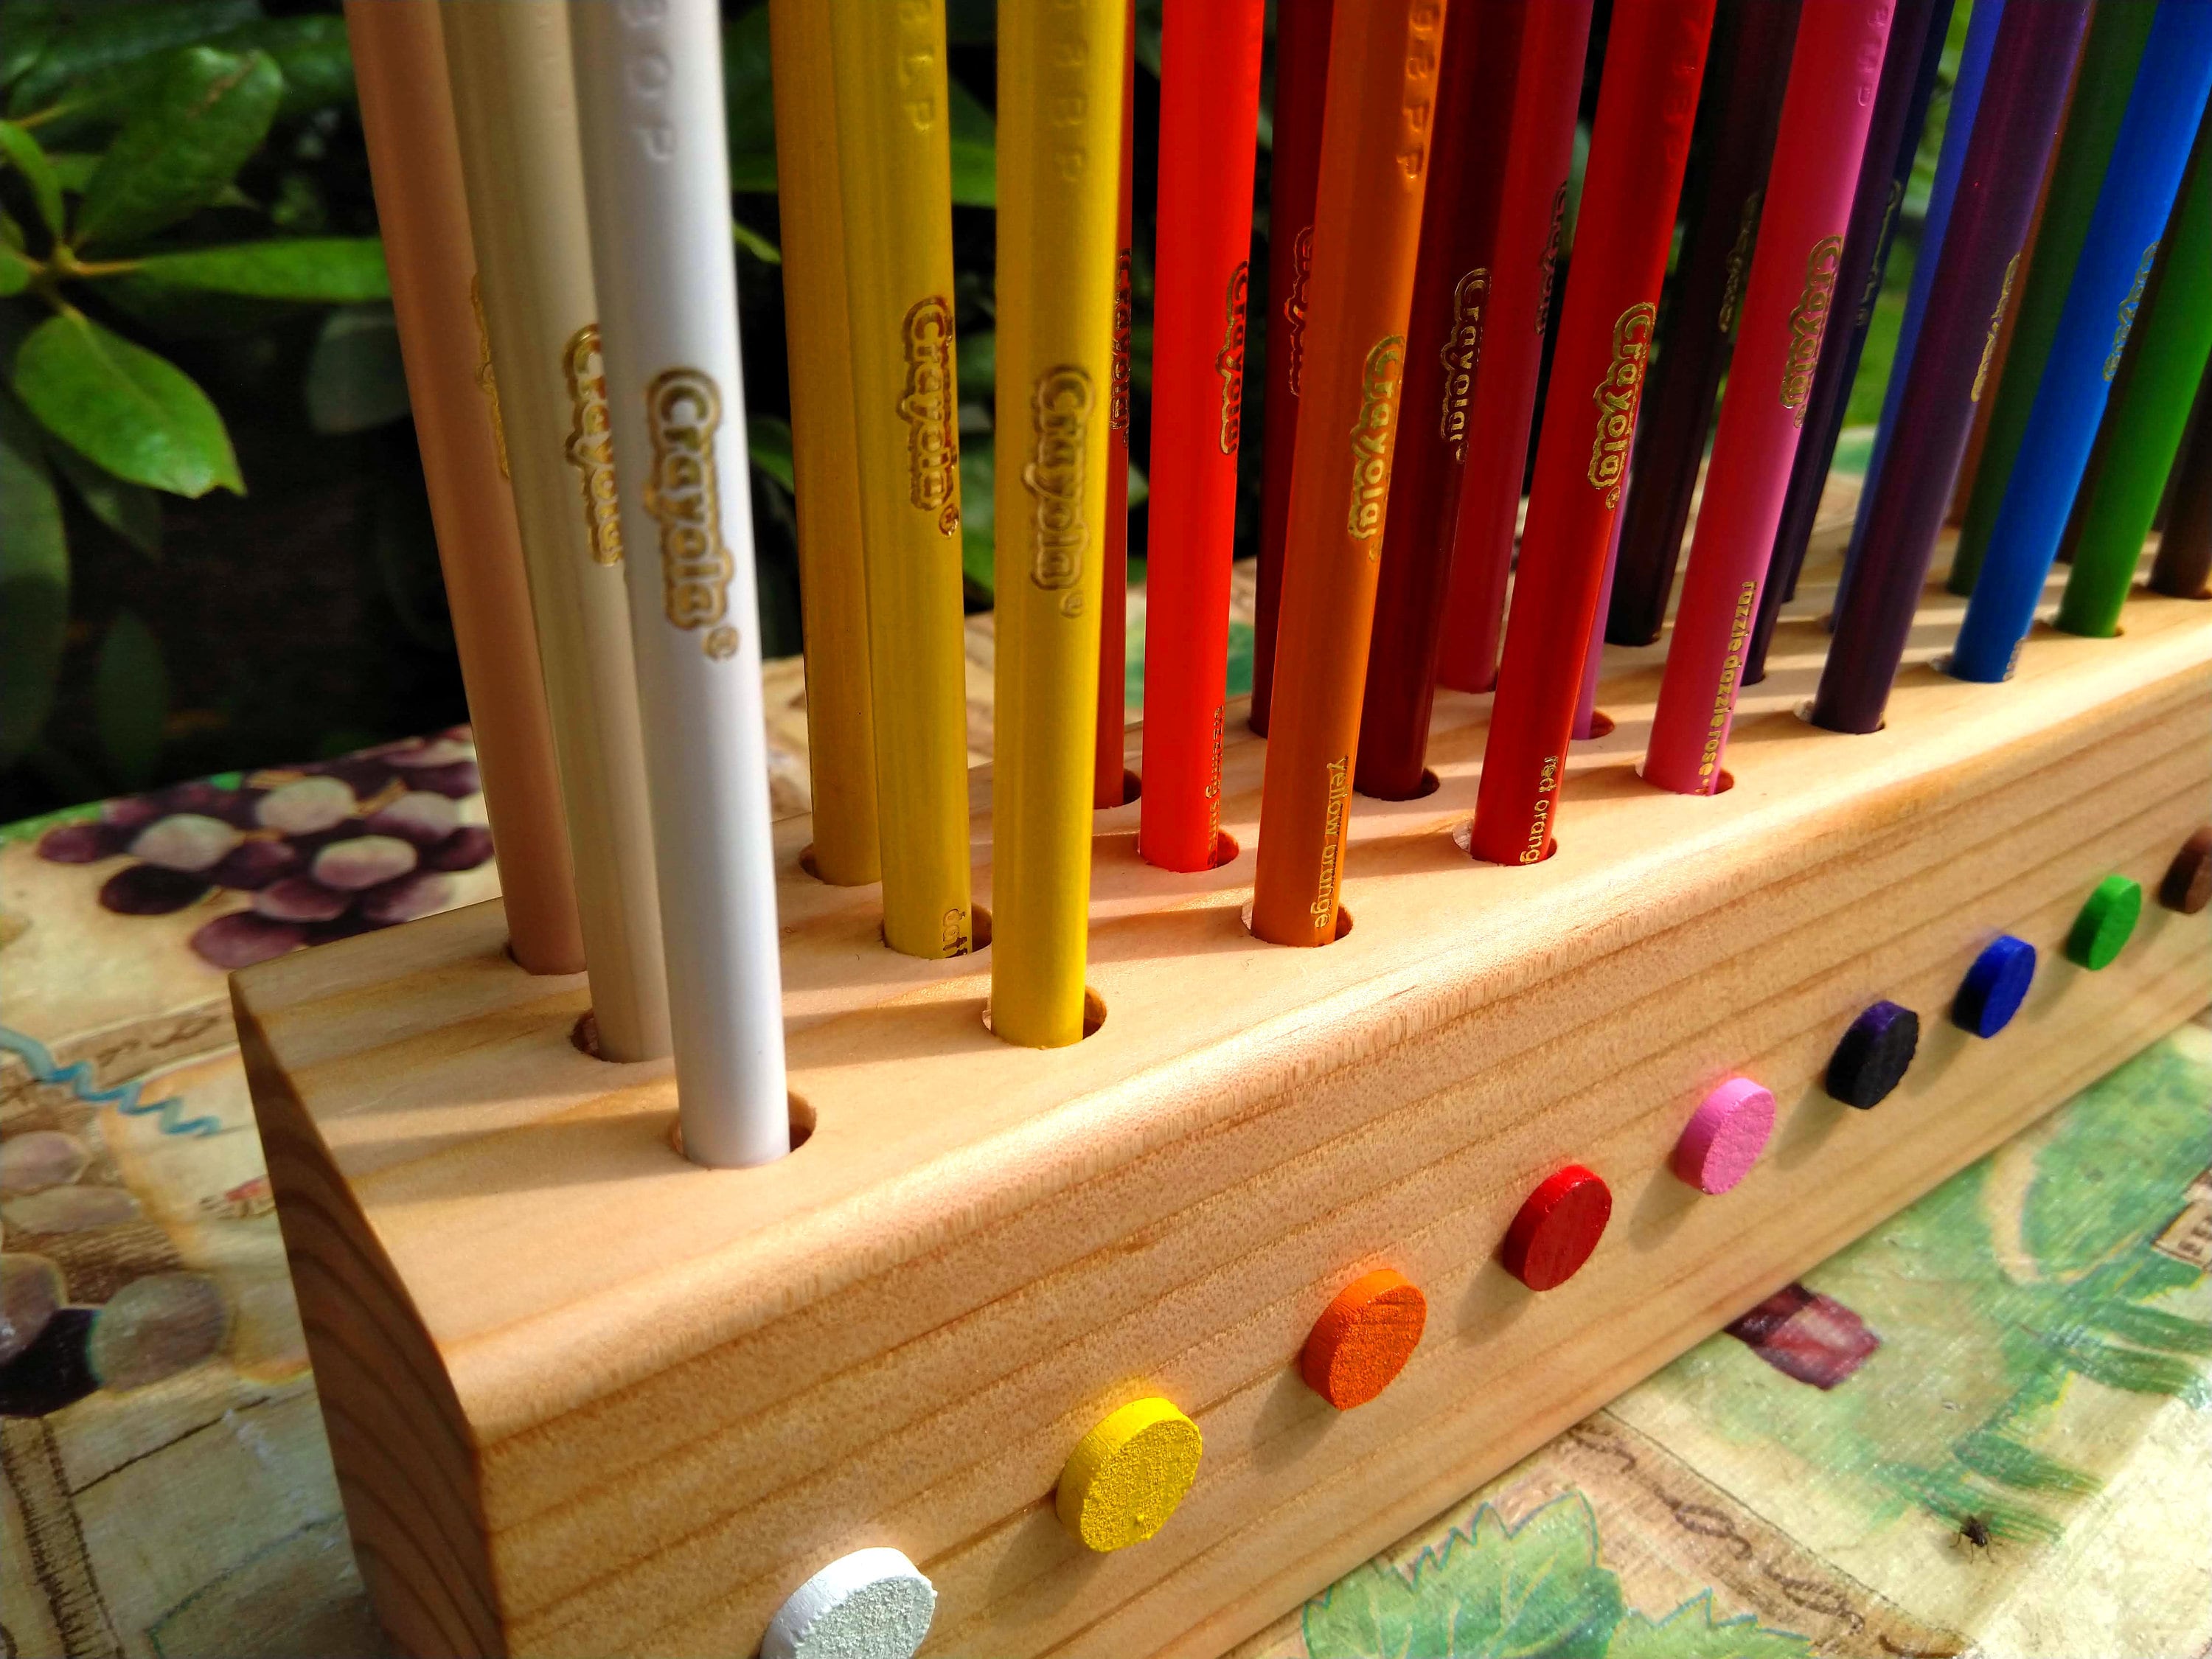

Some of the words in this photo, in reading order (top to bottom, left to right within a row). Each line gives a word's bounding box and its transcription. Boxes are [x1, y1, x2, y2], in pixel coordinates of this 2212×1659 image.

[1441, 267, 1491, 442] Crayola
[1781, 236, 1843, 408] Crayola
[896, 296, 956, 511] Crayola
[1347, 335, 1405, 541] Crayola
[1587, 302, 1655, 489] Crayola
[647, 368, 733, 630] Crayola
[1022, 364, 1092, 590] Crayola
[1728, 581, 1757, 652] razzle
[1699, 730, 1722, 776] rose
[1710, 655, 1742, 728] dazzle
[1326, 756, 1349, 836] yellow
[1520, 799, 1550, 863] orang
[1539, 756, 1558, 793] red
[1311, 844, 1338, 929] orange
